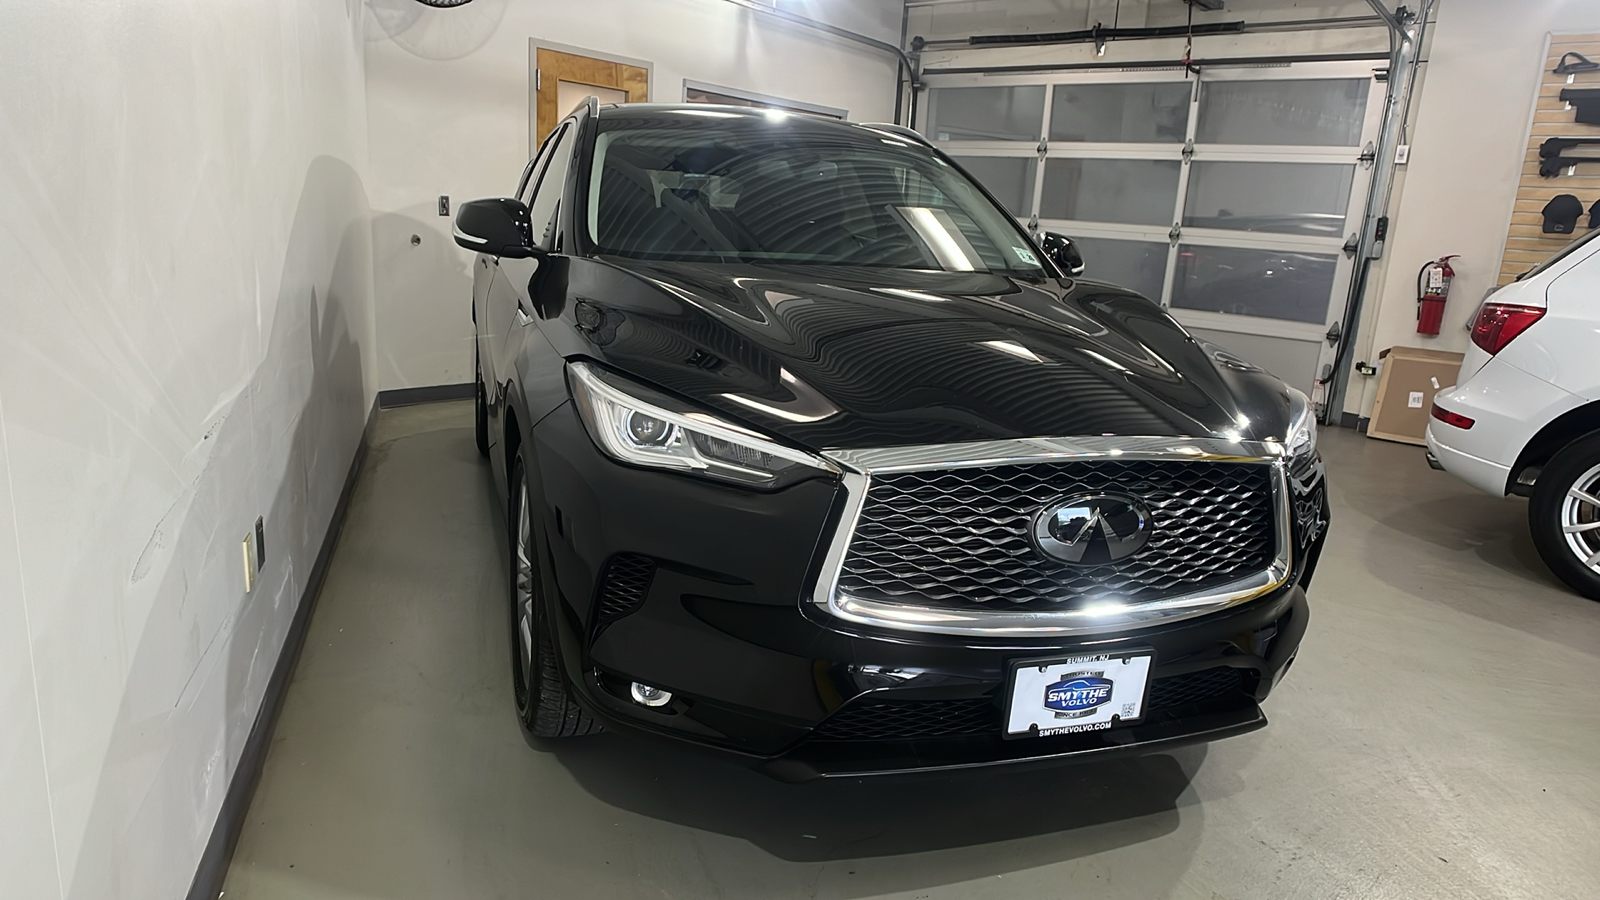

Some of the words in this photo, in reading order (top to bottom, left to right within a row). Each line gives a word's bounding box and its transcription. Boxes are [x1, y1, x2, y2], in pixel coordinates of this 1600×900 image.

[1047, 688, 1108, 702] SMYTHE
[1061, 697, 1098, 707] VOLVO
[1039, 722, 1112, 737] SMYTHEVOLVO.COM
